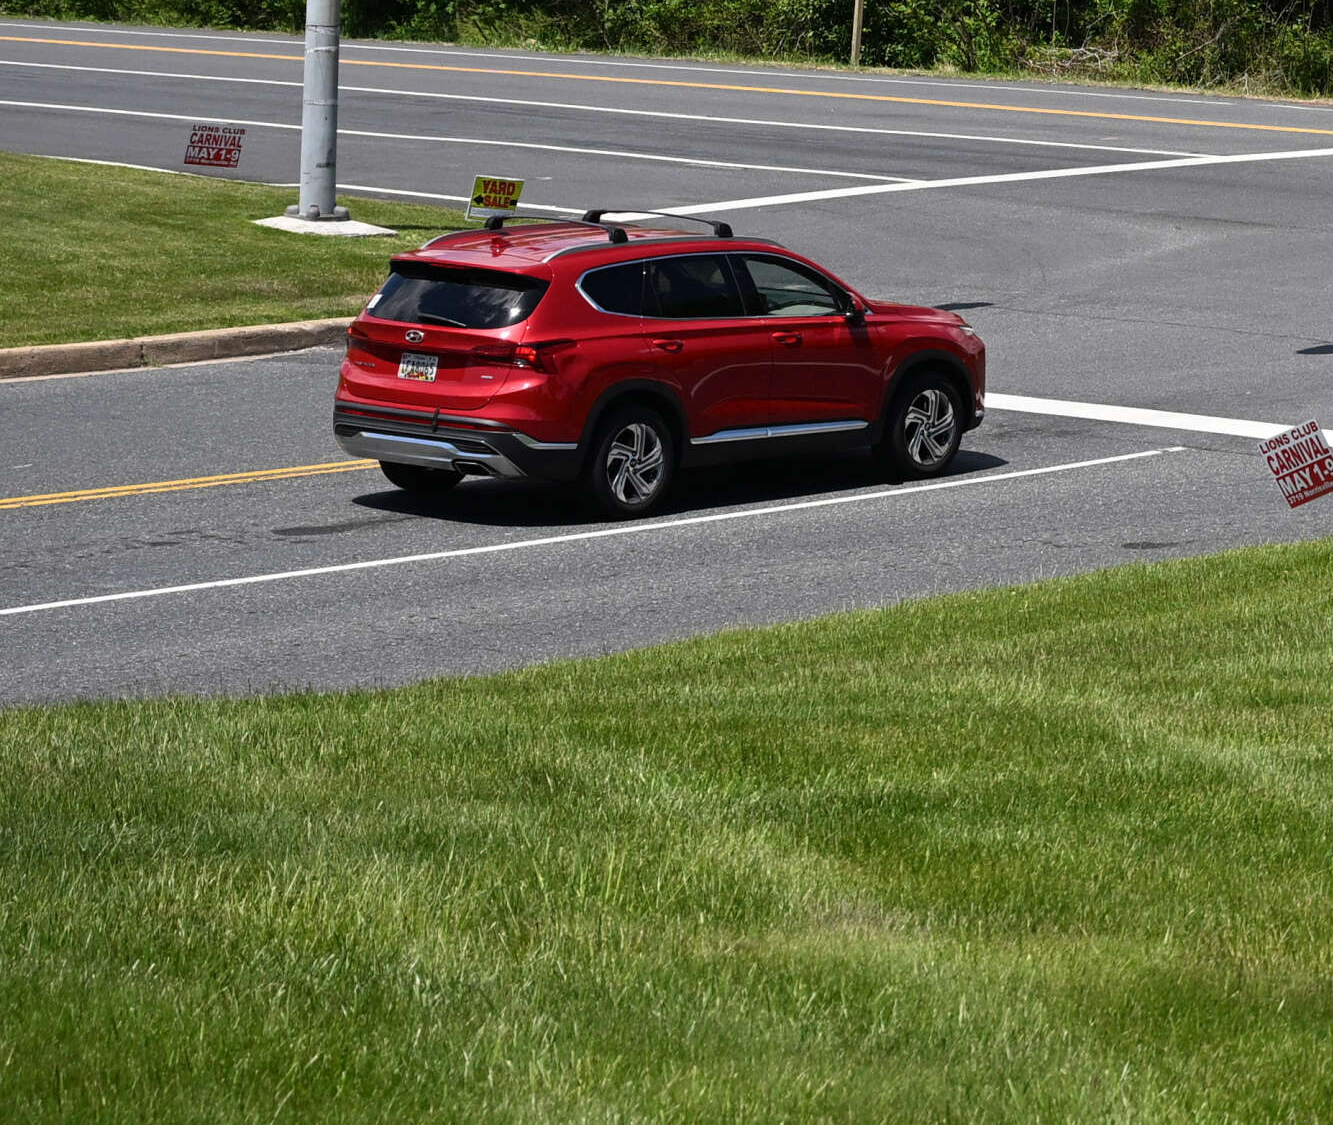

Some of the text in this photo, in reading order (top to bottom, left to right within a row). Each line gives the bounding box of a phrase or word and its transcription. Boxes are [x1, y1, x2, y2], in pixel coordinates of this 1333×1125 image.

[192, 124, 247, 135] LIONS CLUB
[189, 132, 243, 148] CARNIVAL
[186, 146, 217, 160] MAY
[219, 149, 240, 162] 1-9
[482, 180, 516, 196] YARD
[483, 195, 511, 209] SALE
[1259, 420, 1319, 455] LIONS CLUB
[1266, 434, 1330, 476] CARNIVAL
[1278, 467, 1314, 497] MAY
